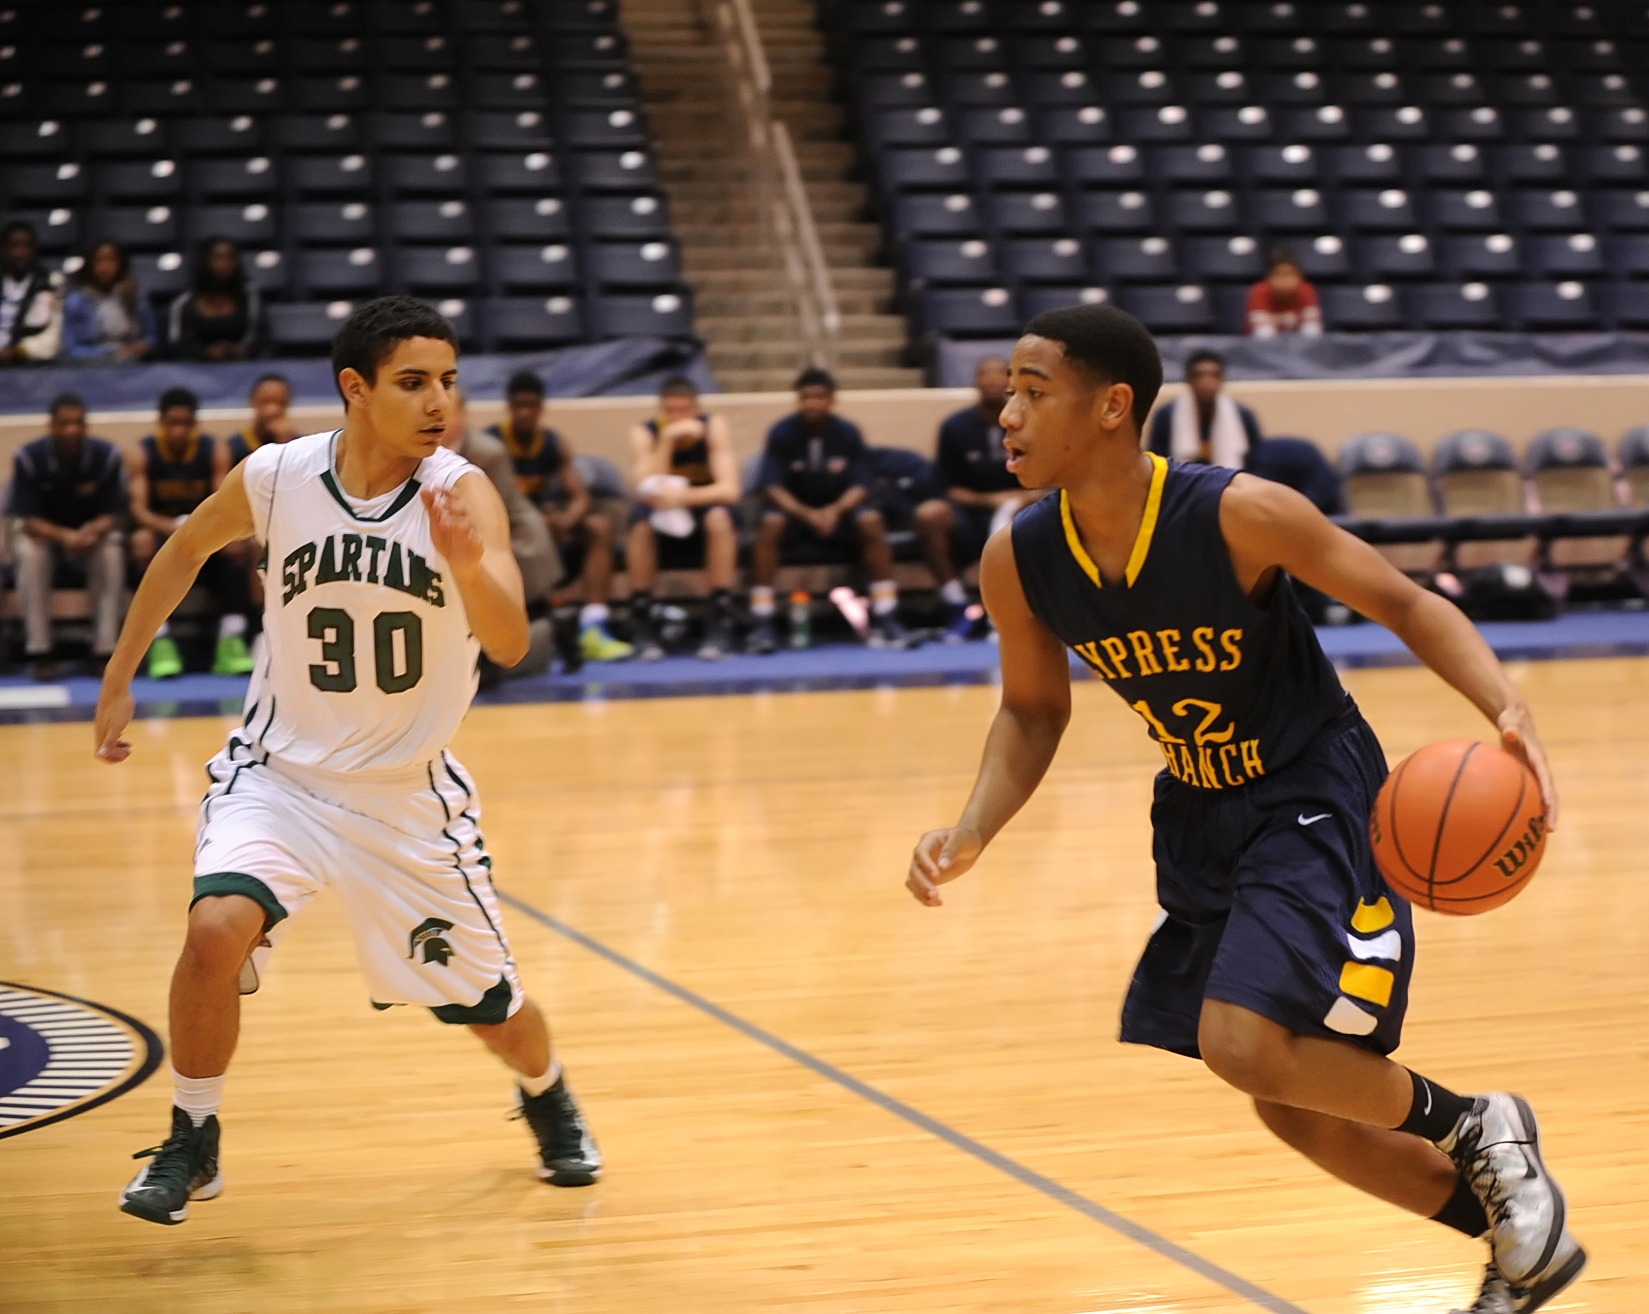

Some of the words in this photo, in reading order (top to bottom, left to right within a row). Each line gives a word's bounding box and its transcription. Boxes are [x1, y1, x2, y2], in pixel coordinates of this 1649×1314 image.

[282, 533, 446, 608] SPARTANS
[307, 606, 424, 695] 30
[1073, 626, 1244, 680] YPRESS
[1132, 698, 1236, 746] 12
